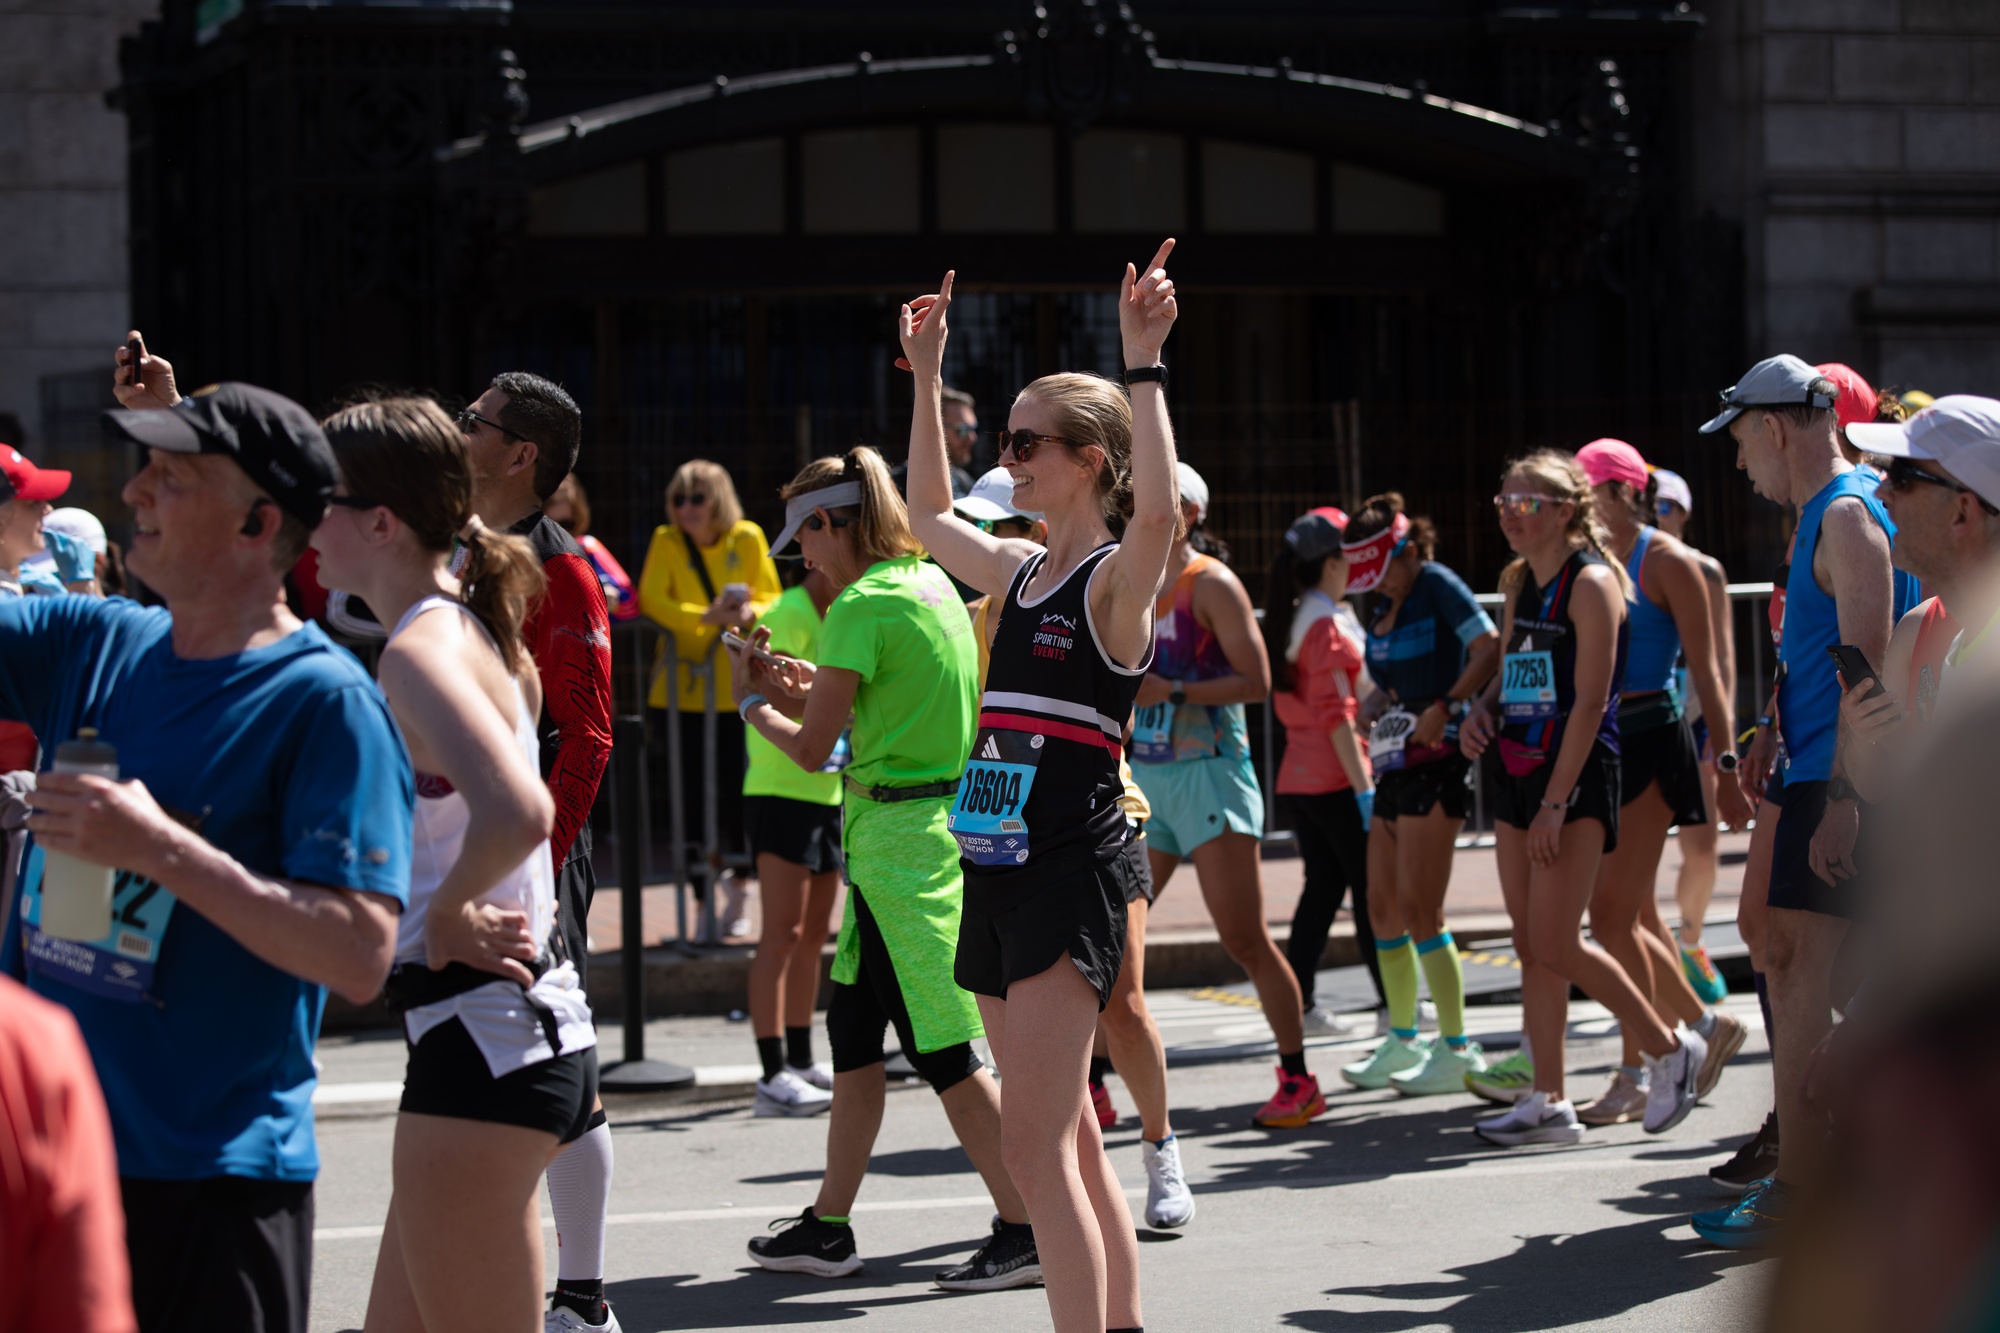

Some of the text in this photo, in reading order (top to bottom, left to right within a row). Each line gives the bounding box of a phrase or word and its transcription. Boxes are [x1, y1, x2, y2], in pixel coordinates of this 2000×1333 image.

[1040, 624, 1070, 637] ADRENALINE
[1032, 632, 1073, 650] SPORTING
[1032, 644, 1066, 661] EVENTS
[1505, 658, 1548, 690] 17253
[959, 767, 1023, 816] 16604
[967, 837, 992, 846] BOSTON
